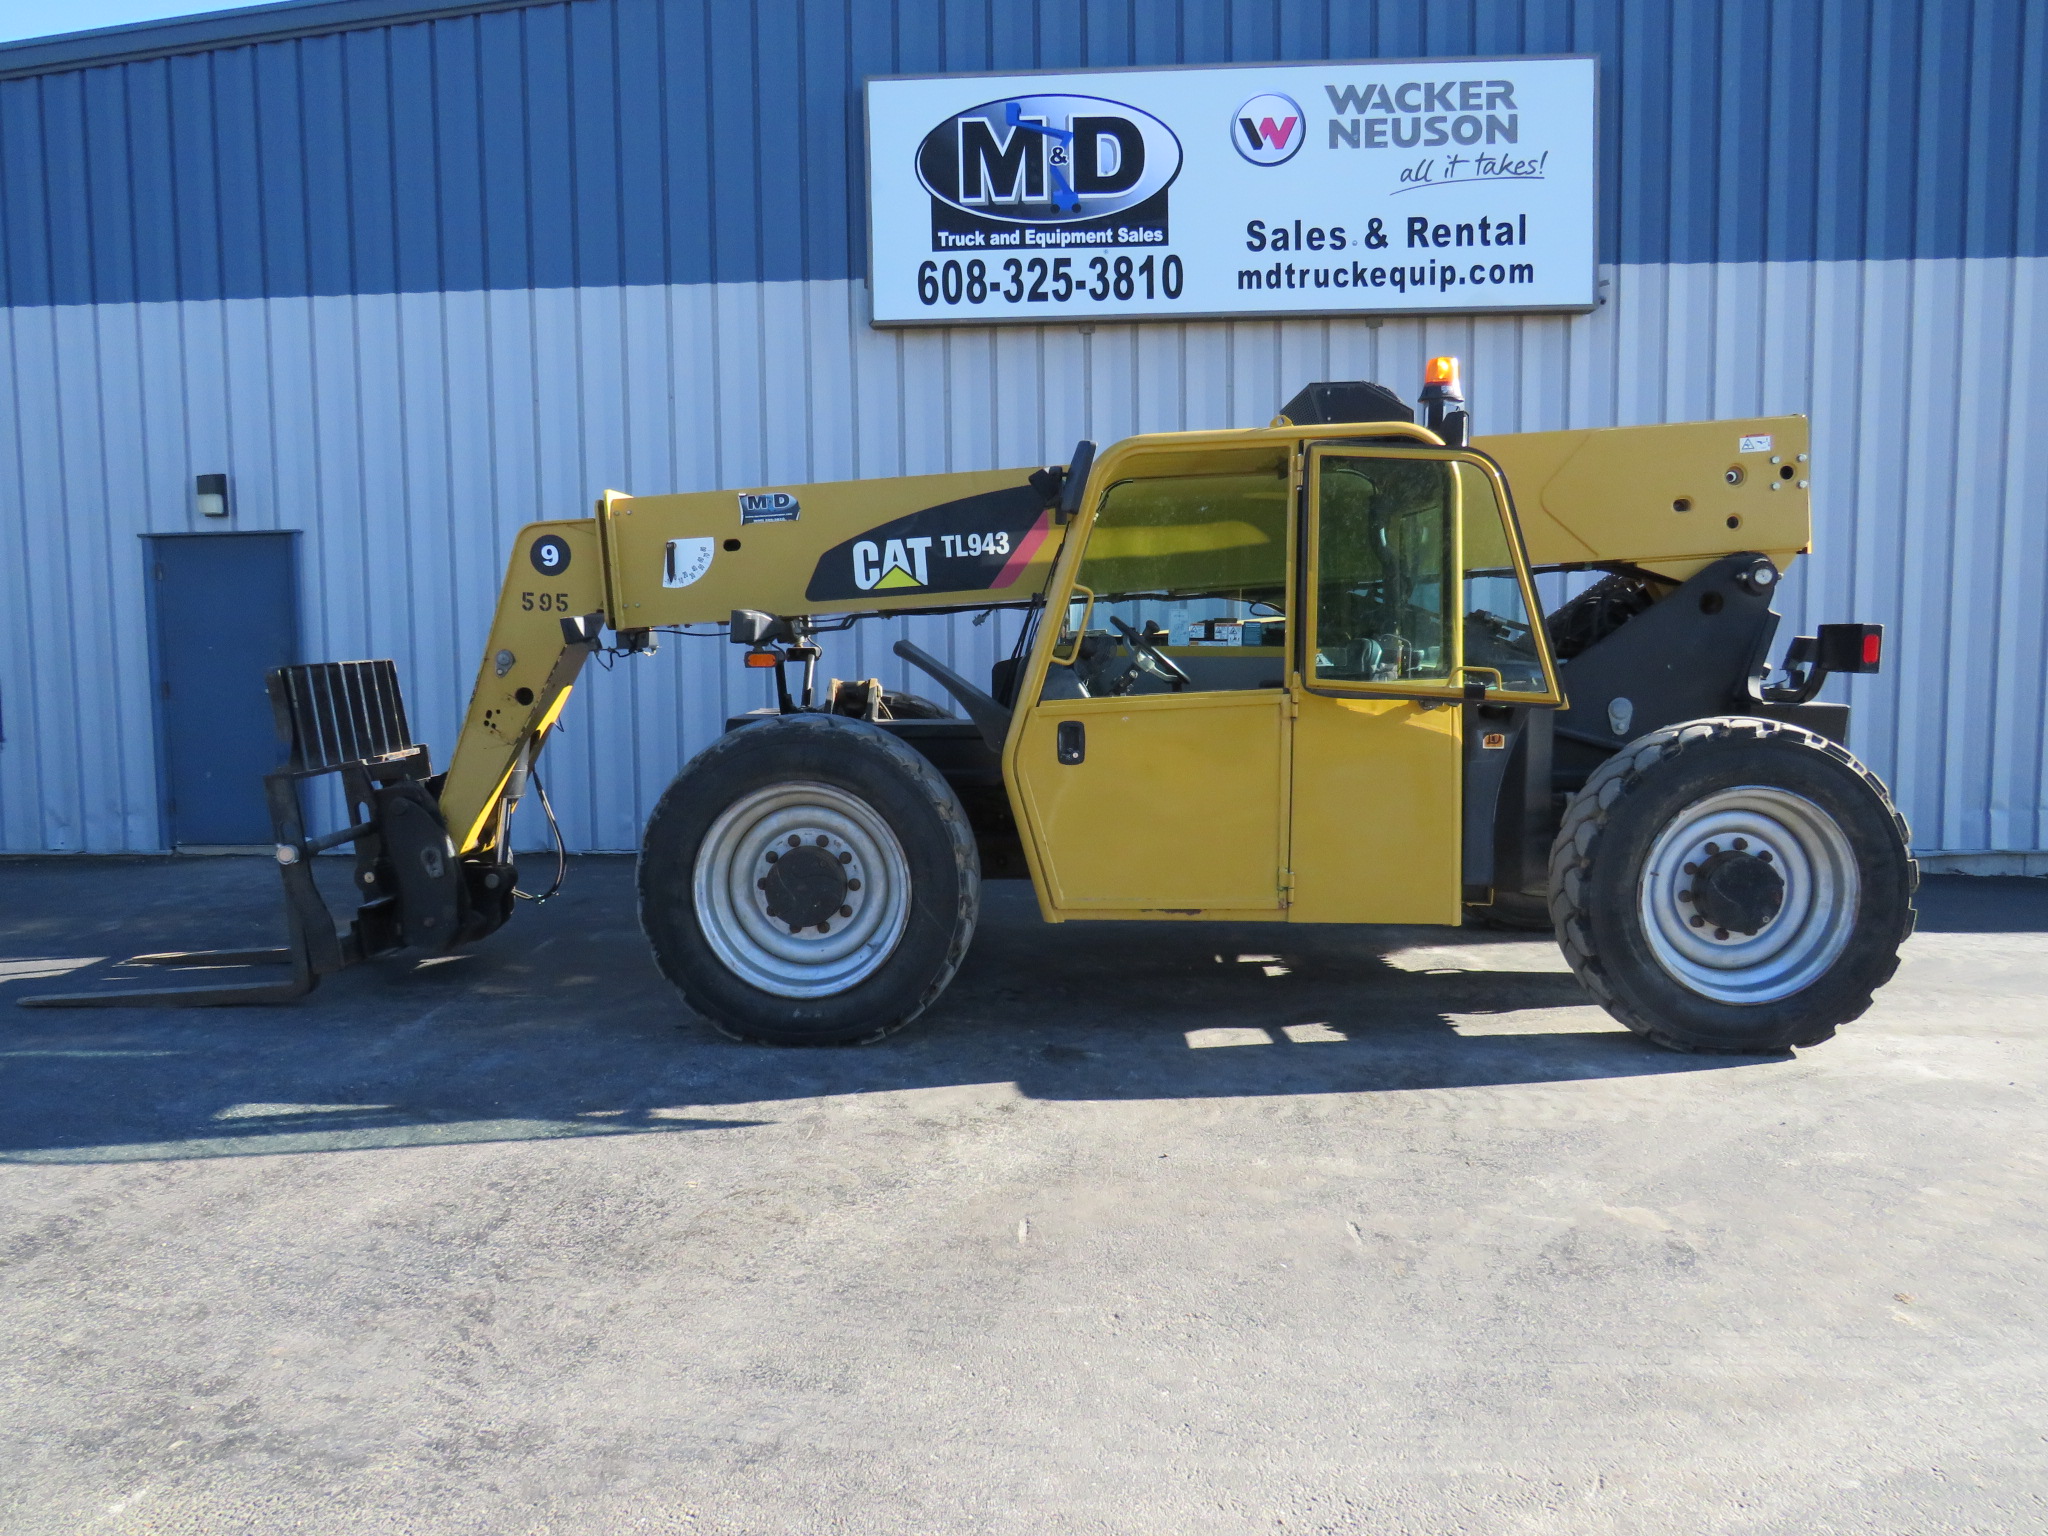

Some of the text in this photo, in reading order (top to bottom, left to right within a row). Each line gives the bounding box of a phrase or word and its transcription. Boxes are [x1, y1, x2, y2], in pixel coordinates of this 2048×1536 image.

[1324, 80, 1518, 115] WACKER
[1239, 116, 1298, 150] W
[1328, 113, 1518, 149] NEUSON
[1400, 150, 1548, 183] all it takes!
[938, 227, 1163, 248] Truck and Equipment Sales
[1246, 214, 1527, 252] Sales & Rental
[917, 254, 1184, 306] 608-325-3810
[1237, 258, 1534, 293] mdtruckequip.com
[540, 544, 560, 567] 9
[941, 531, 1010, 558] TL943
[852, 536, 932, 590] CAT
[522, 591, 569, 612] 595
